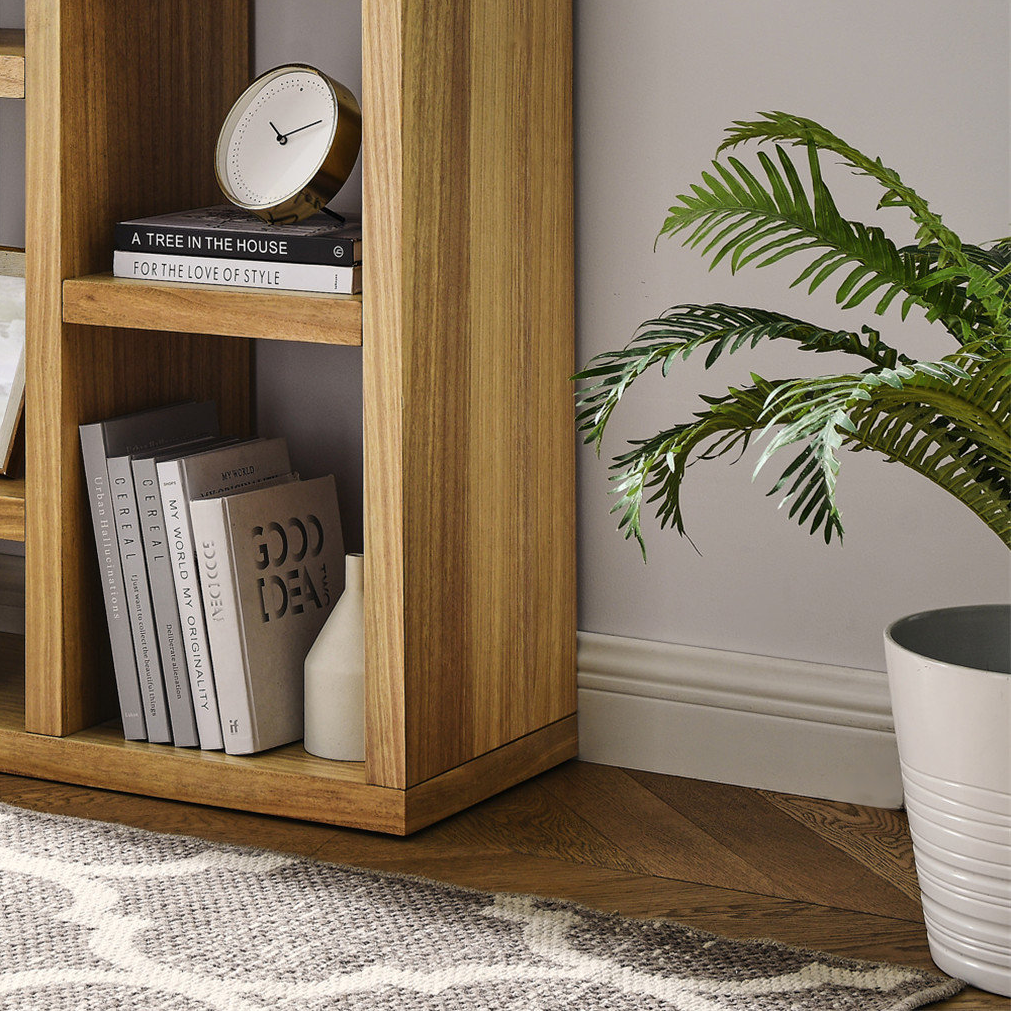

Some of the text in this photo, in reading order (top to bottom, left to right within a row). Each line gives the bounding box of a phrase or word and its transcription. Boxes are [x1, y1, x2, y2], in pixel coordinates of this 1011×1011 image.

[131, 232, 288, 255] A TREE IN THE HOUSE
[133, 261, 280, 285] FOR THE LOVE OF STYLE
[114, 477, 136, 560] CEREAL
[142, 479, 164, 561] CEREAL
[94, 476, 120, 619] Urban Hallucinations
[251, 514, 324, 570] GOOD
[131, 578, 139, 592] just
[137, 613, 143, 621] to
[169, 499, 209, 710] MY WORLD MY ORIGINALITY
[138, 620, 147, 646] collect
[144, 659, 155, 693] beautiful
[166, 624, 182, 700] Deliberate alienation
[149, 693, 157, 717] things
